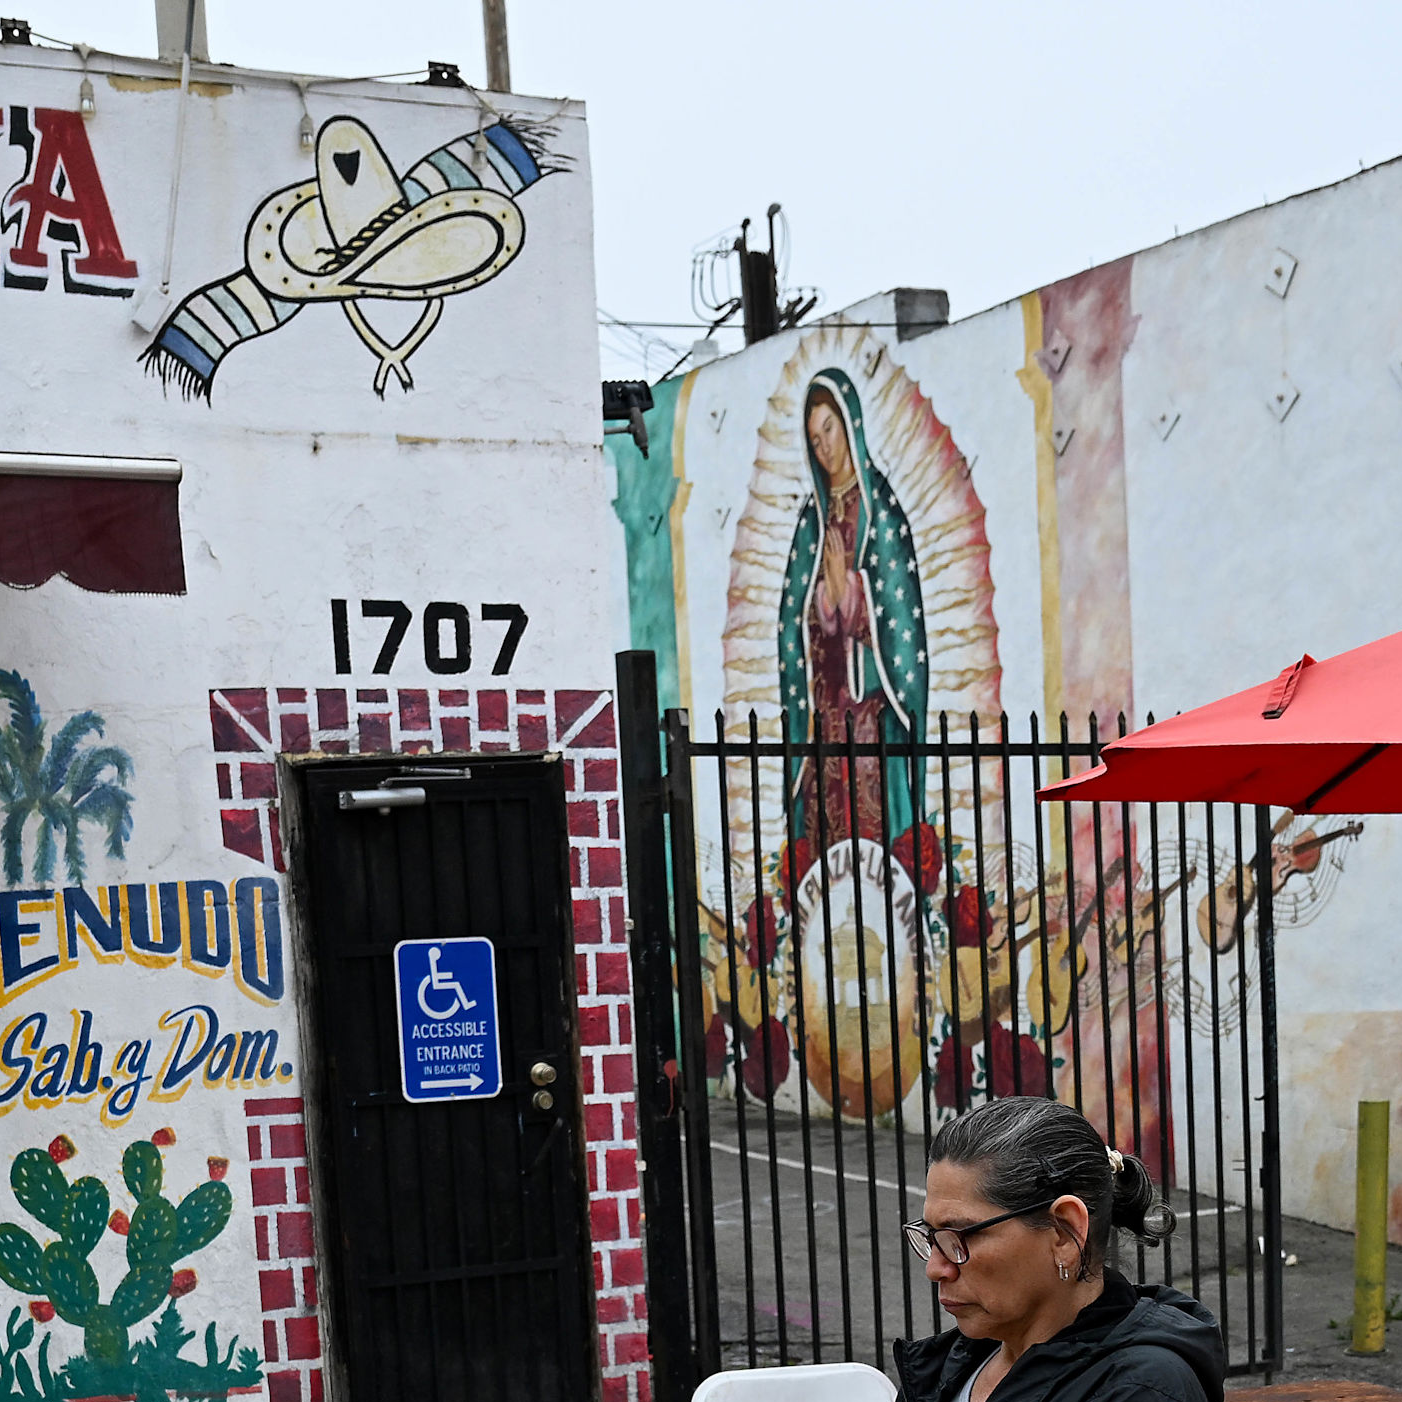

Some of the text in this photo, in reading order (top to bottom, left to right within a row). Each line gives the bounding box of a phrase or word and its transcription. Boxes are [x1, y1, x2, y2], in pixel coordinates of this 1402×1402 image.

[331, 599, 529, 676] 1707
[412, 1021, 487, 1040] ACCESSIBLE
[151, 1005, 293, 1103] Dom.
[417, 1044, 484, 1062] ENTRANCE
[424, 1063, 480, 1075] IN BACK PATIO
